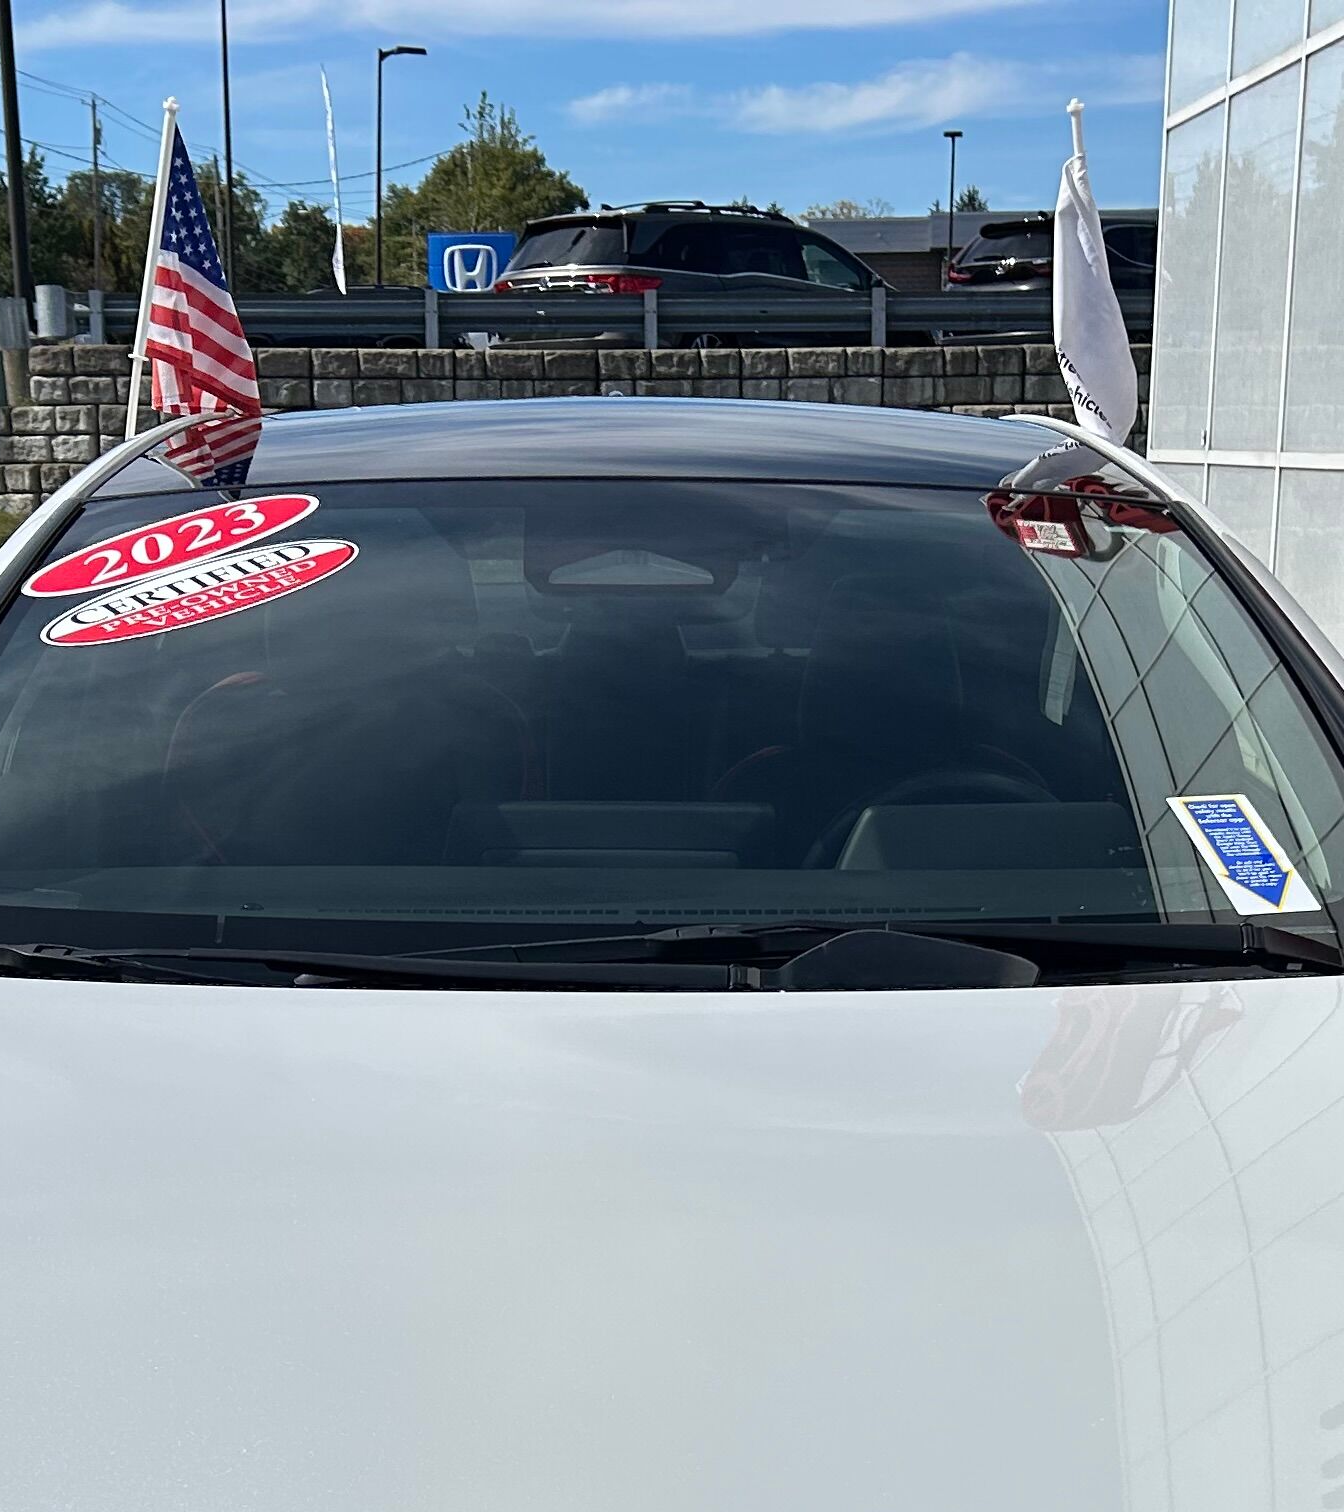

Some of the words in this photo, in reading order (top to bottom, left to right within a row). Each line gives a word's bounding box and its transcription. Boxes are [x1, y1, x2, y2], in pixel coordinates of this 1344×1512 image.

[83, 503, 266, 585] 2023
[70, 544, 311, 625] CERTIFIED
[100, 559, 317, 633] PRE-OWNED
[144, 576, 302, 627] VEHICLE
